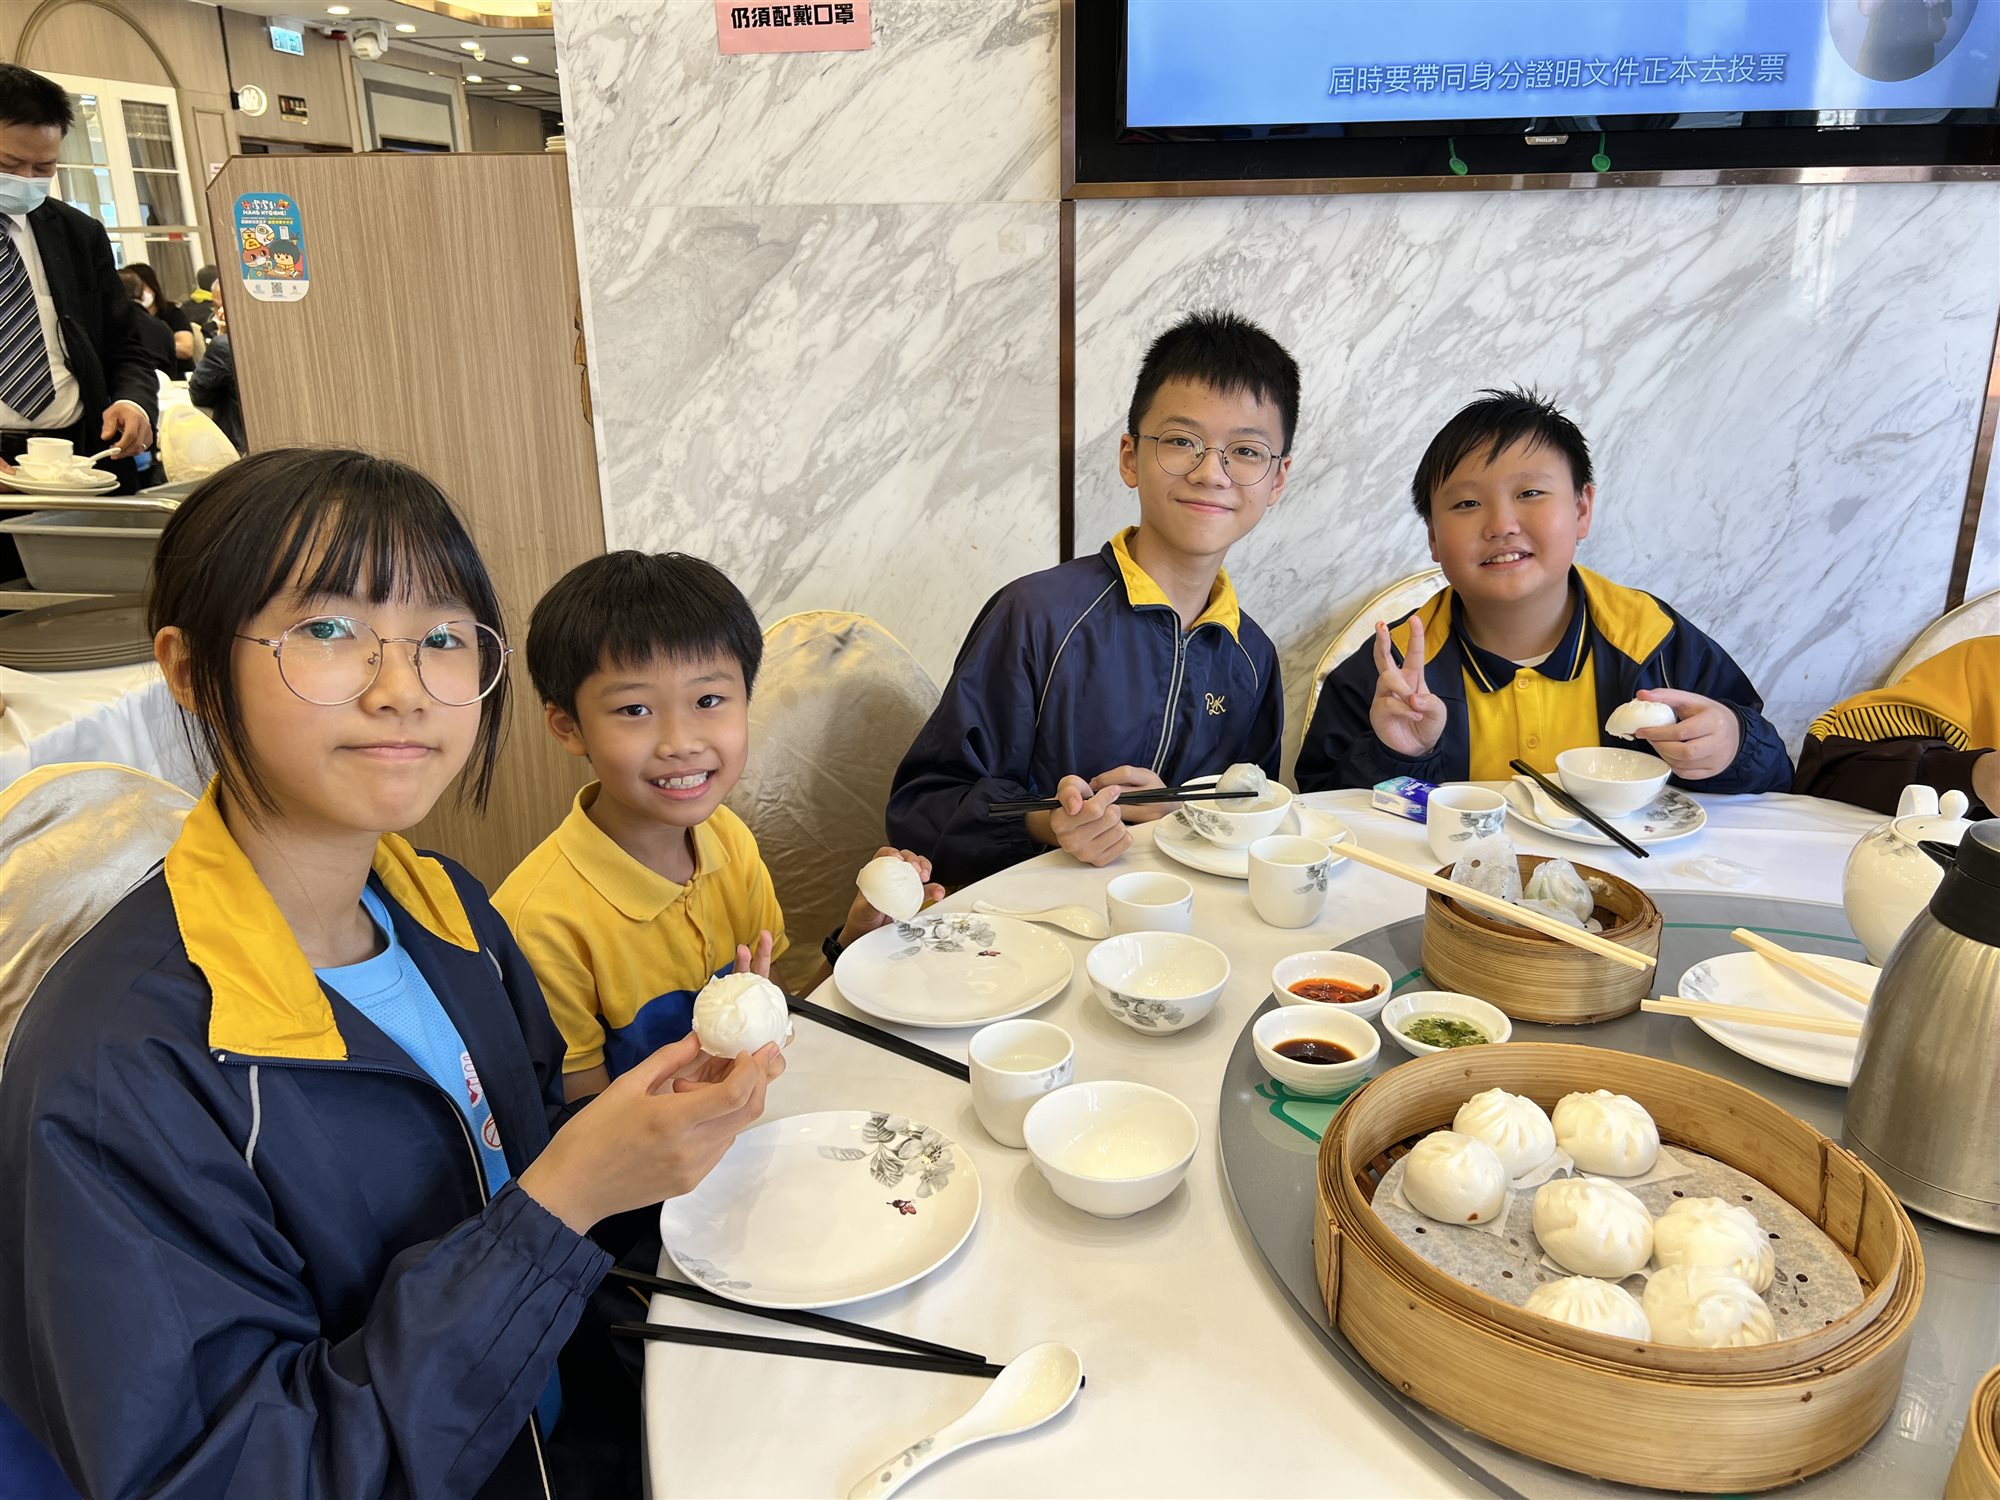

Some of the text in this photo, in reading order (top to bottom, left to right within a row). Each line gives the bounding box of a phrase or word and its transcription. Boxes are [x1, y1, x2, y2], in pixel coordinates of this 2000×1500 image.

[731, 3, 855, 29] 仍須配戴口罩
[1328, 53, 1788, 95] 屆時要帶同身分證明文件正本去投票
